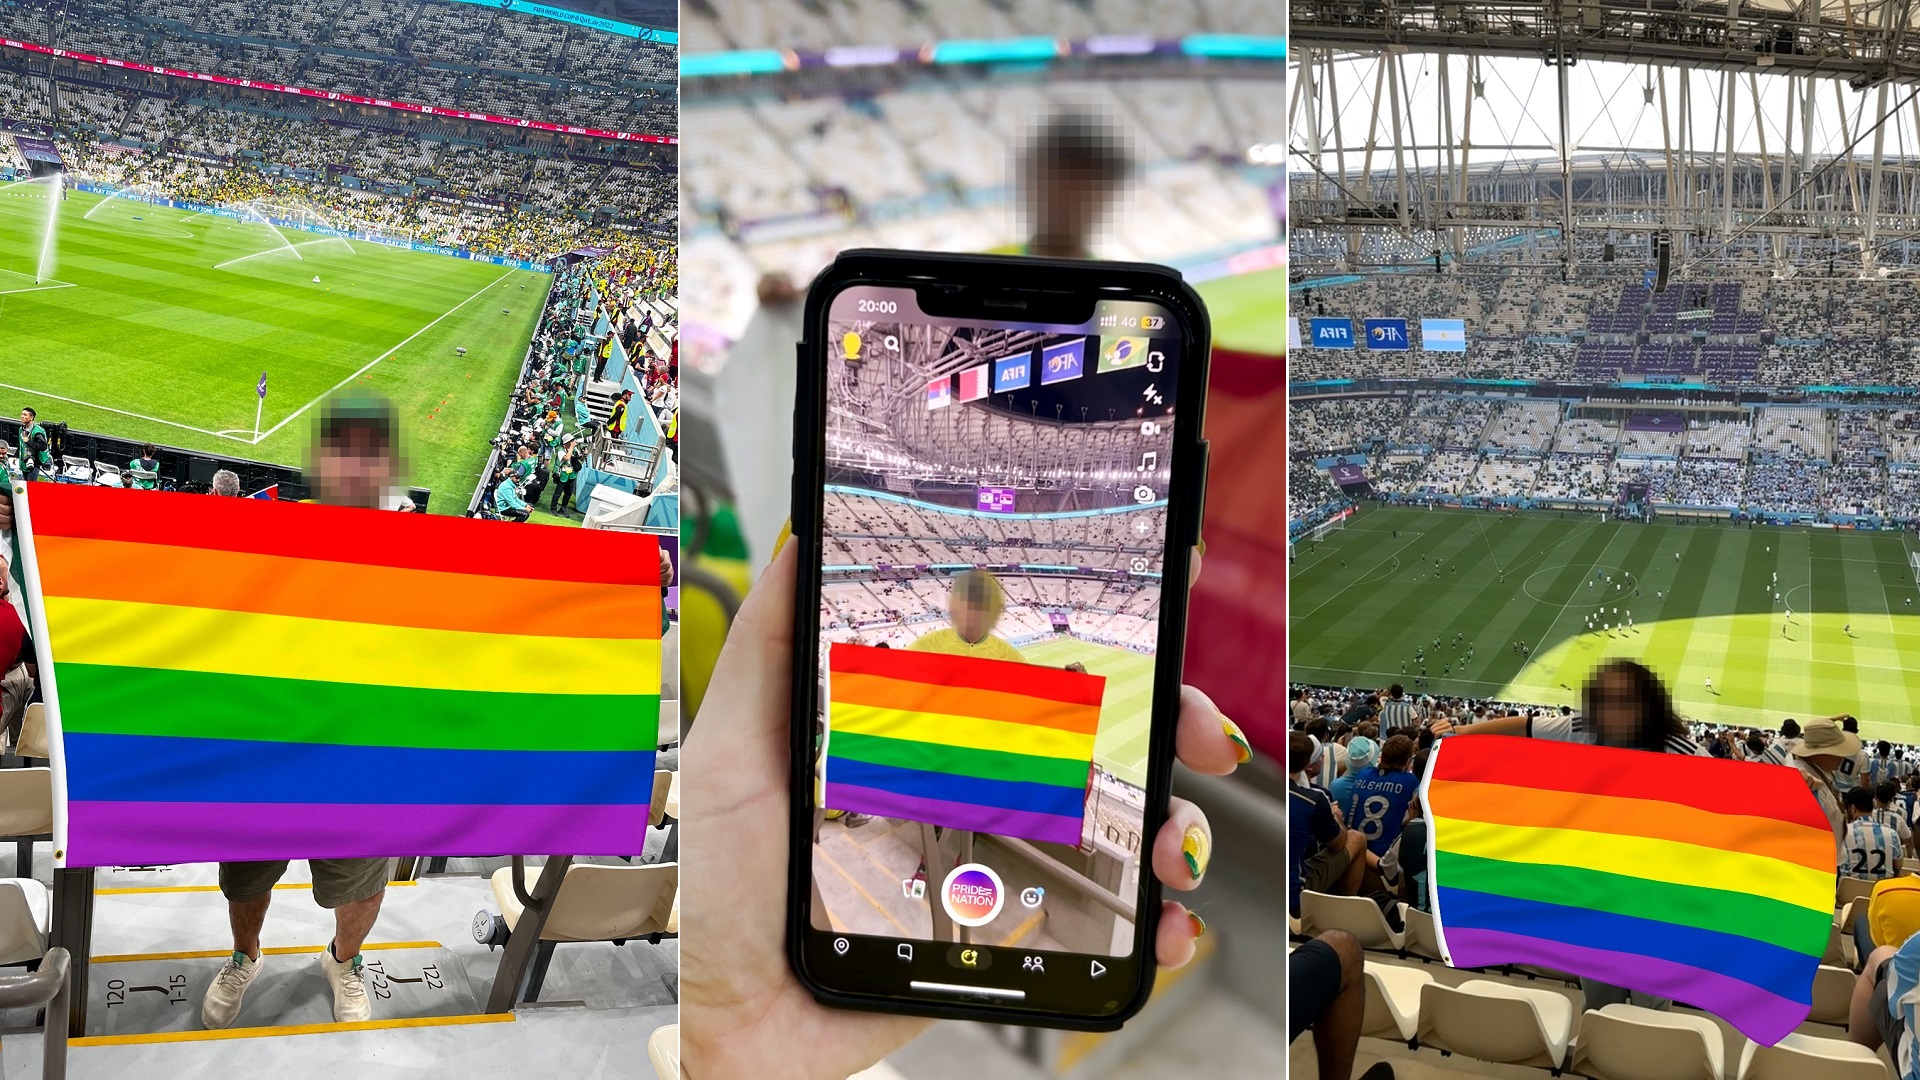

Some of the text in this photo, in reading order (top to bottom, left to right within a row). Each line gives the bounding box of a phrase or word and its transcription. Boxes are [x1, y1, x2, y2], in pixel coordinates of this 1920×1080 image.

[533, 6, 545, 14] FIFA
[545, 9, 563, 18] WORLD
[599, 21, 614, 29] 2022
[93, 187, 105, 195] PLAY
[215, 209, 237, 217] COMPETE
[415, 244, 439, 253] COMPETE
[440, 248, 454, 256] NOW
[858, 299, 897, 314] 20:00
[1121, 317, 1159, 328] 4G 37
[1347, 793, 1390, 841] 18
[1851, 848, 1887, 874] 22
[952, 883, 993, 896] PRIDE
[951, 894, 994, 907] NATION
[367, 959, 392, 1000] 17-22
[422, 963, 444, 990] 122
[106, 979, 125, 1009] 120
[169, 974, 187, 1006] 1-15
